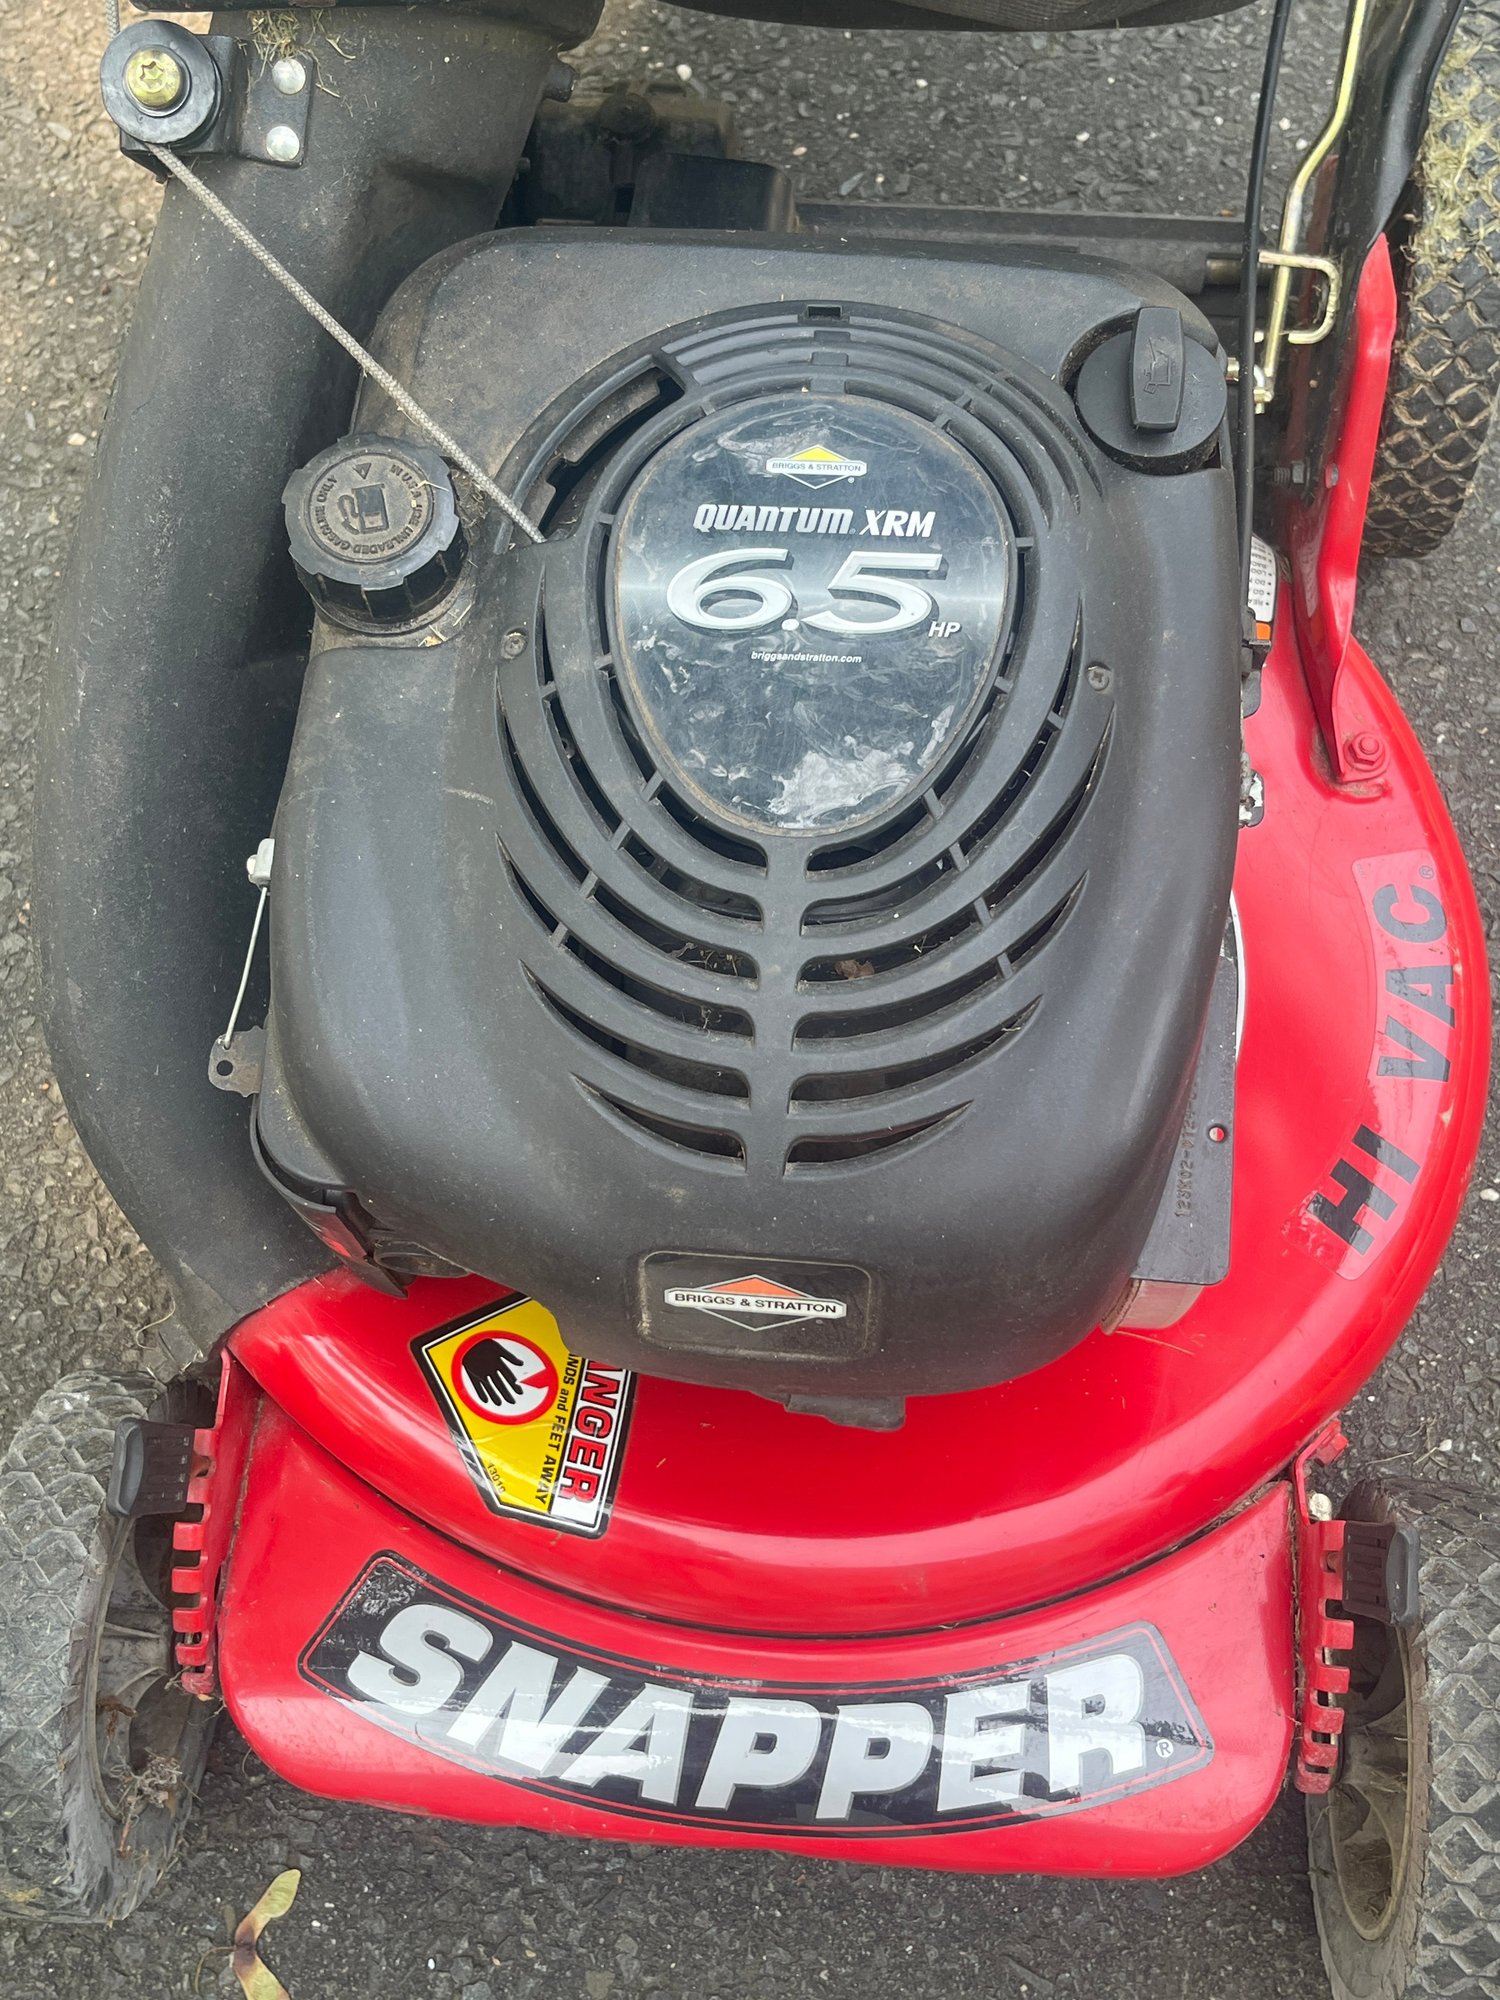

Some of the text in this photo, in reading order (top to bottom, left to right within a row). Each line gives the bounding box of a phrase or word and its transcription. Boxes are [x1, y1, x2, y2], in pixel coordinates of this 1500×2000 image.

[771, 461, 862, 472] BRIGGS & STRATTON
[316, 474, 337, 503] ONLY
[693, 504, 936, 538] QUANTUM XRM
[353, 525, 413, 554] UNLEADED
[666, 547, 961, 638] 6.5 HP
[751, 651, 862, 664] briggsandstratton.com
[1306, 884, 1455, 1256] HI VAC
[674, 1293, 837, 1314] BRIGGS & STRATTON
[556, 1388, 570, 1412] and
[548, 1415, 566, 1452] FEET
[535, 1455, 557, 1505] AWAY
[347, 1603, 1149, 1819] SNAPPER
